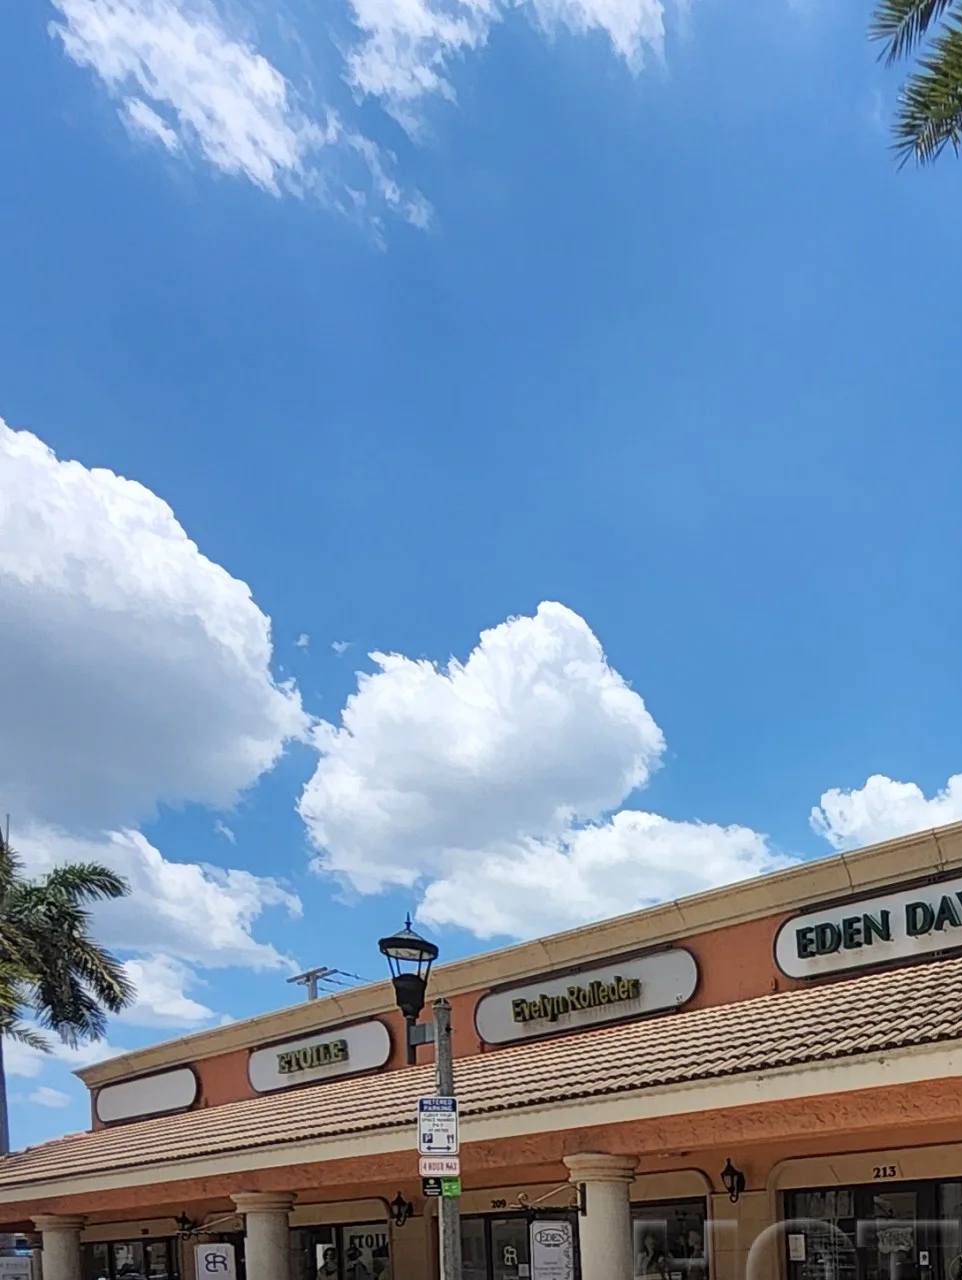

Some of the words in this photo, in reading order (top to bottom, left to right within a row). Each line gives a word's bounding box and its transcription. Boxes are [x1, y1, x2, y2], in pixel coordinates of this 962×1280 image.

[795, 909, 891, 959] EDEN
[512, 993, 569, 1022] Evelyn
[277, 1039, 349, 1074] ETOILE
[873, 1166, 897, 1178] 213
